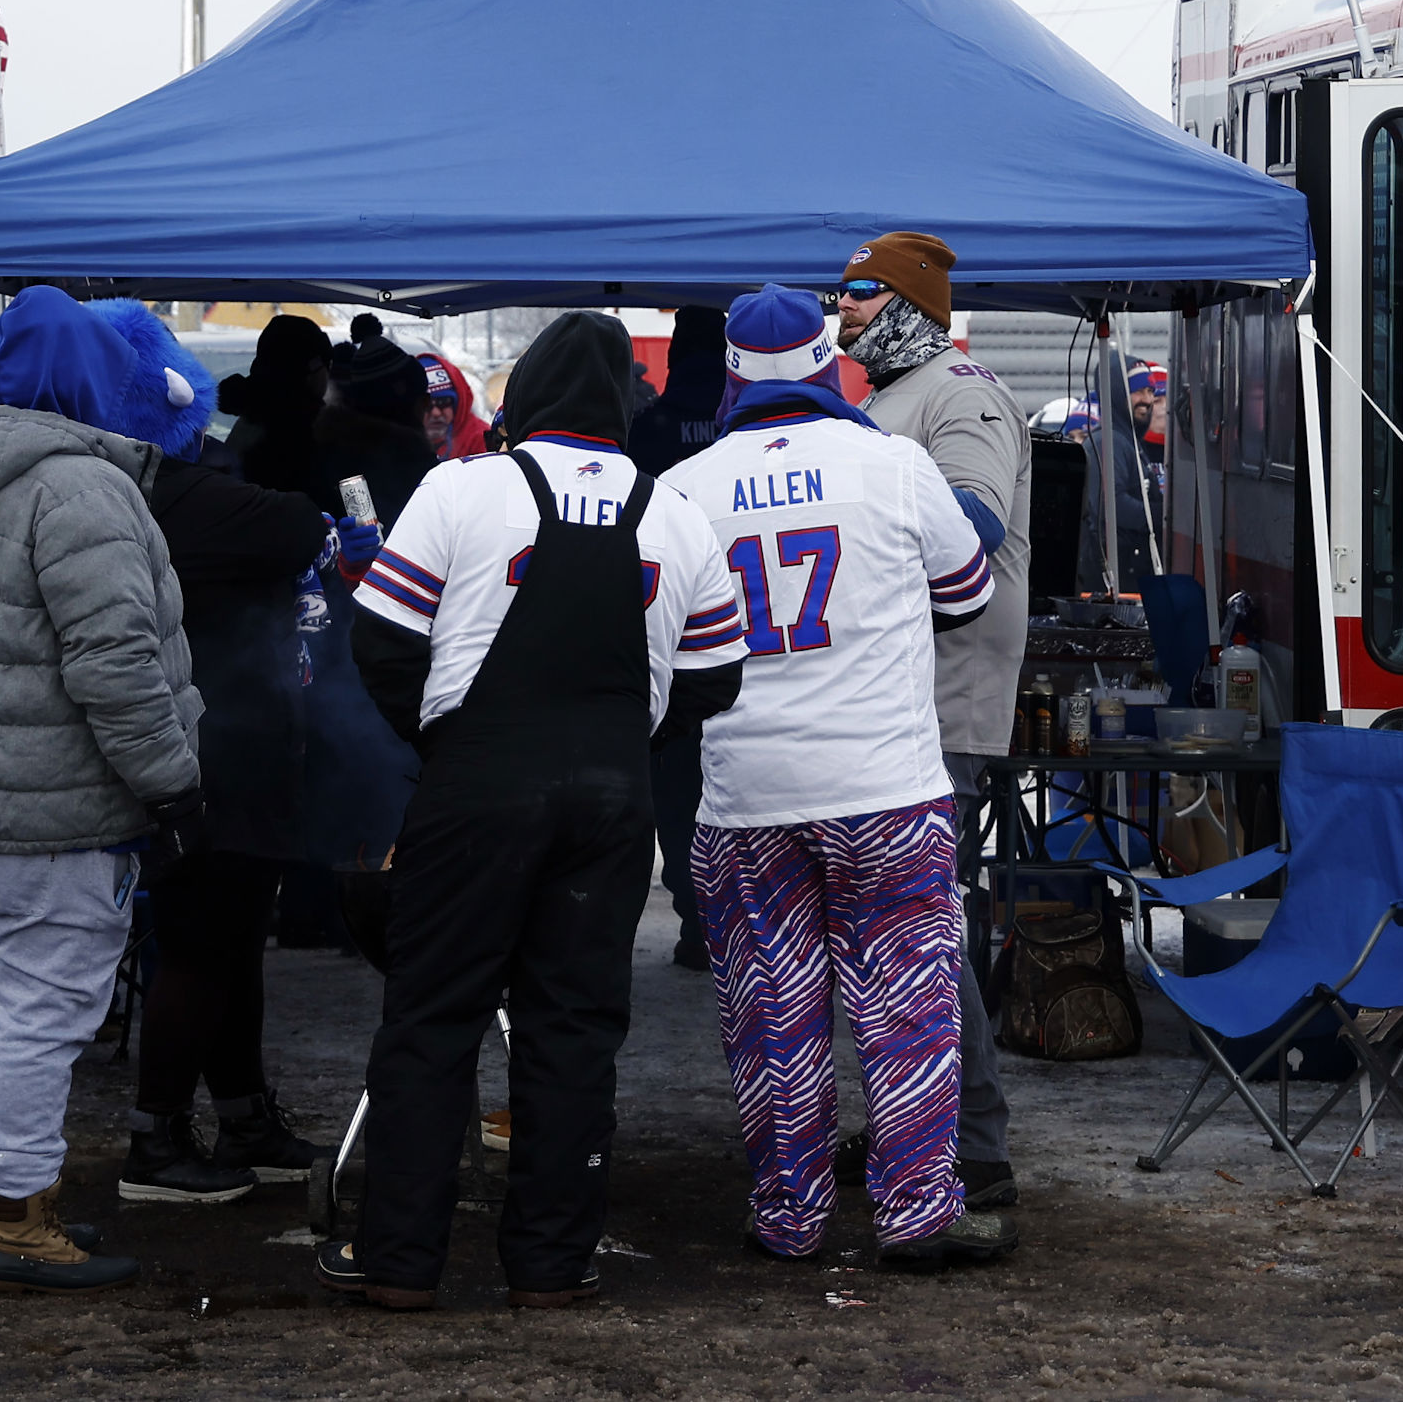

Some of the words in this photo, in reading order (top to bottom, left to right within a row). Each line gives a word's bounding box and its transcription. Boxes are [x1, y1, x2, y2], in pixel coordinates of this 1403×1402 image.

[812, 338, 832, 364] BIL
[733, 469, 824, 512] ALLEN
[727, 525, 841, 657] 17
